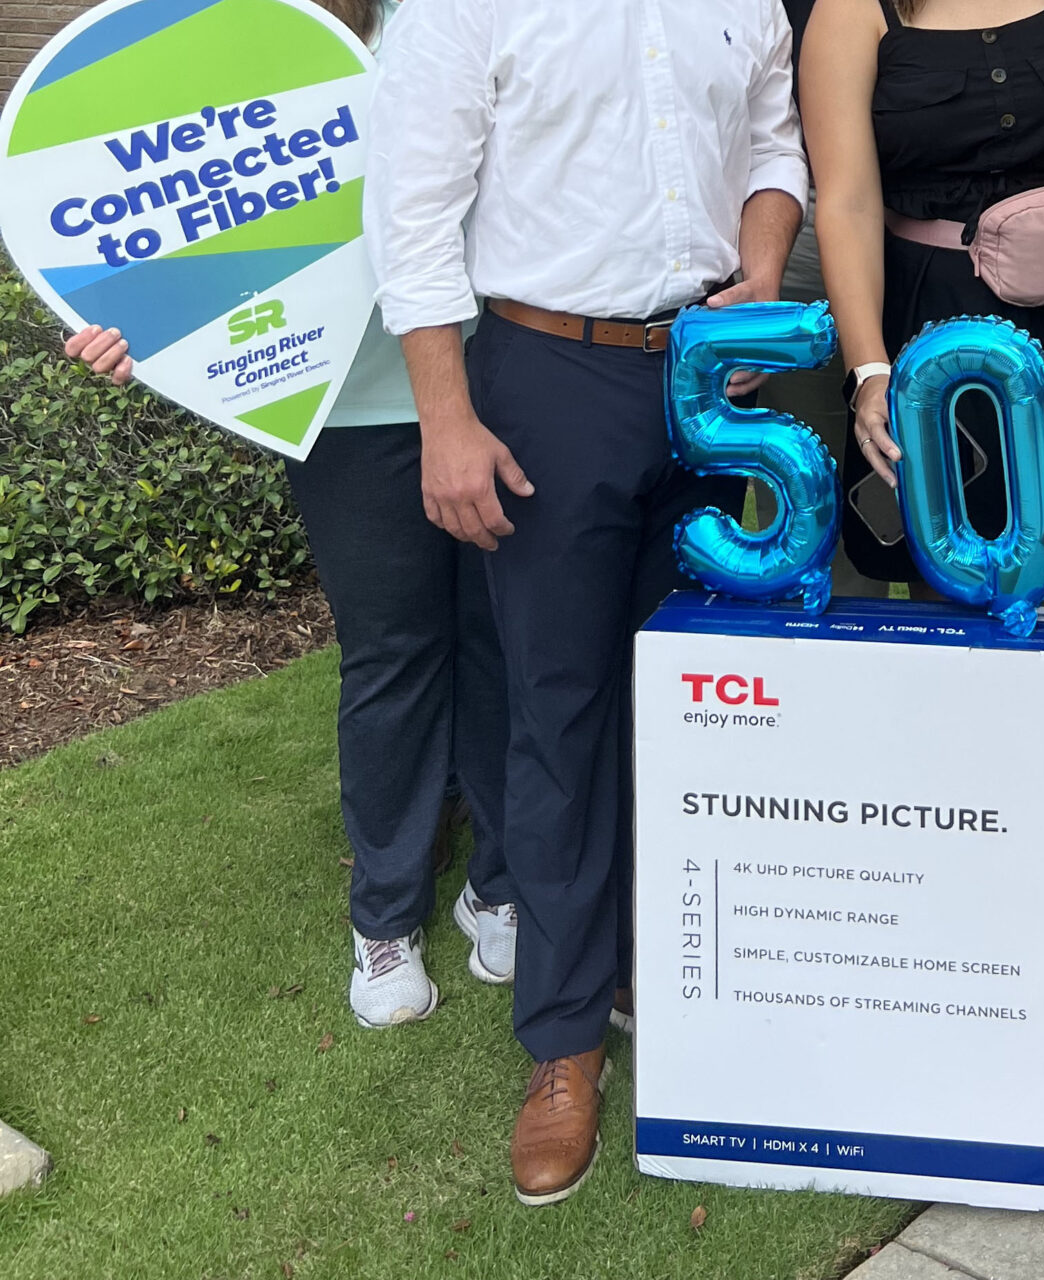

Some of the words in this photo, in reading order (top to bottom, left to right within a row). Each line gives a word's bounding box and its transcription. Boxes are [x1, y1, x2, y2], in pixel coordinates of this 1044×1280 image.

[105, 99, 276, 173] We're
[50, 105, 360, 238] Connected
[97, 228, 161, 267] to
[177, 158, 340, 242] Fiber!
[228, 299, 287, 345] SR
[207, 344, 277, 379] Singing
[279, 326, 325, 352] River
[235, 350, 308, 387] Connect
[222, 389, 250, 403] Powered
[252, 386, 260, 394] by
[260, 376, 286, 389] Singing
[287, 369, 304, 379] River
[305, 360, 331, 372] Electric
[936, 627, 967, 635] TCL
[681, 673, 779, 706] TCL
[683, 709, 728, 728] enjoy
[682, 792, 848, 823] STUNNING
[861, 802, 1008, 833] PICTURE.
[733, 862, 752, 874] 4K
[757, 864, 788, 876] UHD
[793, 866, 855, 880] PICTURE
[859, 870, 924, 884] QUALITY
[682, 858, 701, 999] 4-SERIES
[733, 905, 769, 918] HIGH
[774, 907, 842, 922] DYNAMIC
[847, 911, 899, 926] RANGE
[733, 947, 790, 963] SIMPLE,
[794, 950, 909, 969] CUSTOMIZABLE
[913, 958, 957, 972] HOME
[962, 961, 1021, 977] SCREEN
[733, 990, 825, 1007] THOUSANDS
[830, 996, 850, 1008] OF
[855, 998, 941, 1014] STREAMING
[946, 1004, 1027, 1020] CHANNELS
[682, 1133, 726, 1147] SMART
[728, 1136, 746, 1148] TV
[763, 1139, 795, 1152] HDMI
[810, 1142, 819, 1153] 4
[836, 1144, 864, 1157] WiFi
